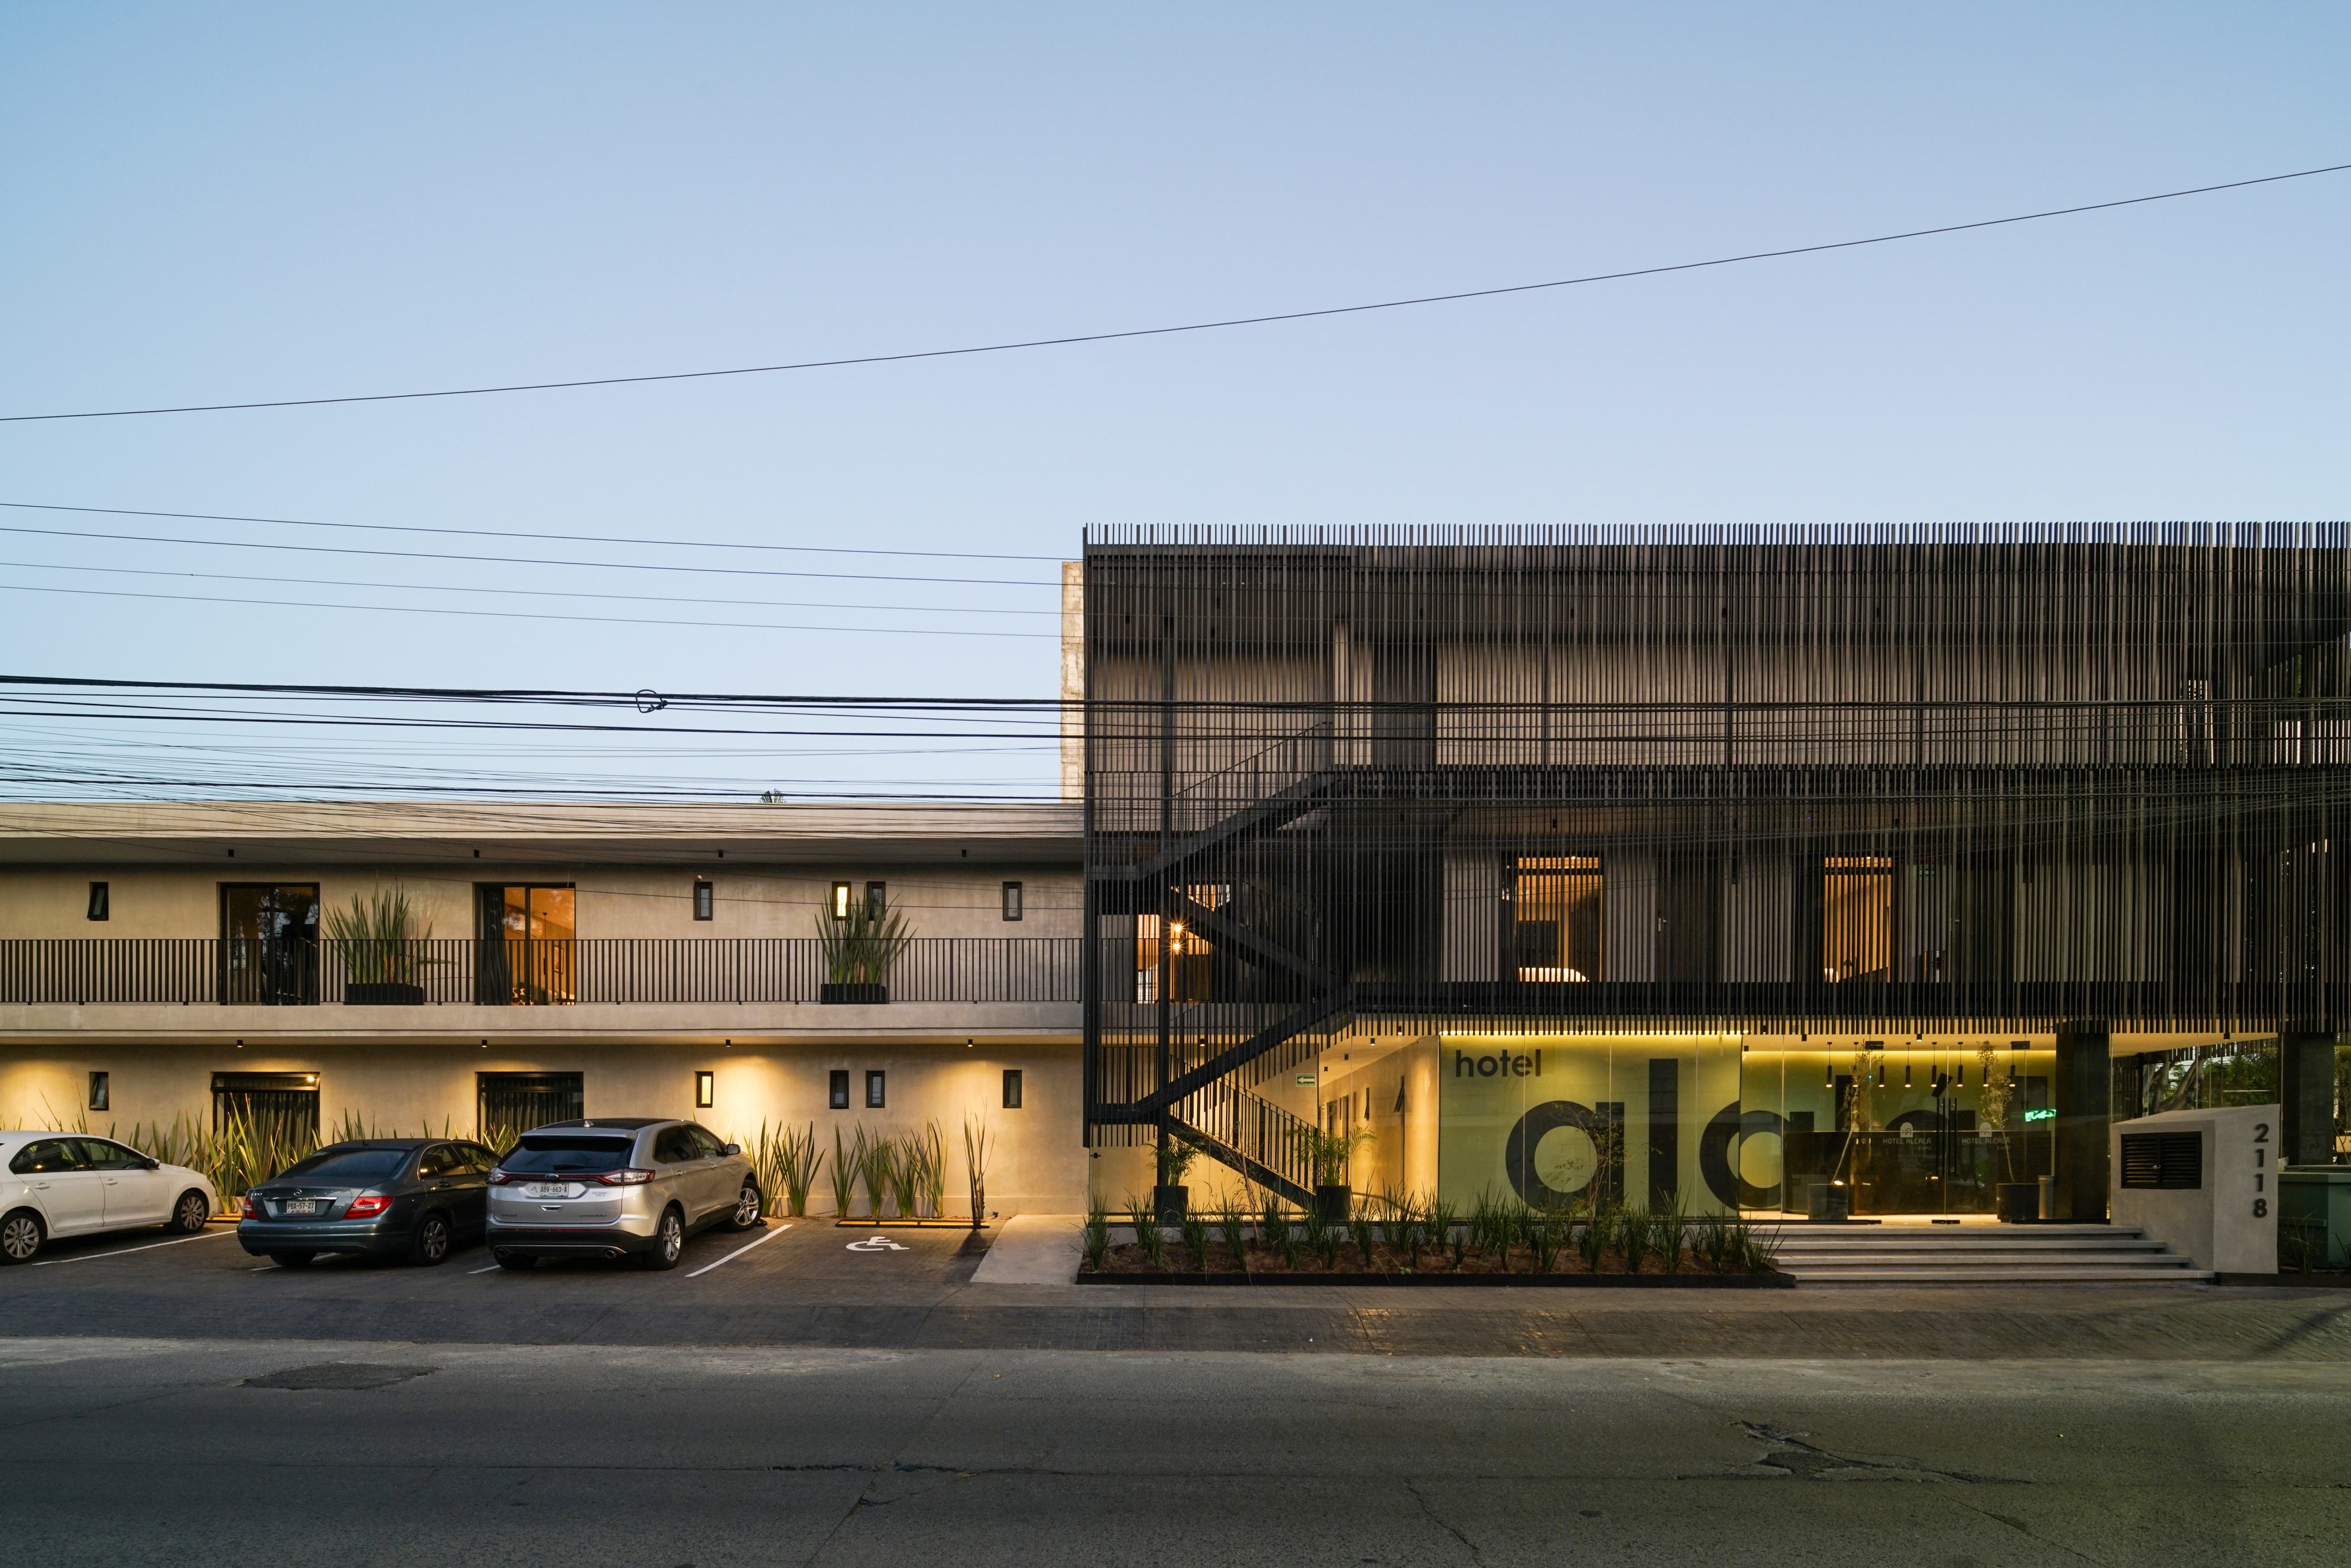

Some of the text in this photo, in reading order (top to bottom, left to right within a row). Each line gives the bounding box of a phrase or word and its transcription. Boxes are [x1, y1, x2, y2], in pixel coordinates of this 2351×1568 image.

[1456, 1049, 1541, 1077] hotel
[1906, 1136, 1931, 1145] ALCALÁ
[2253, 1123, 2269, 1218] 2118
